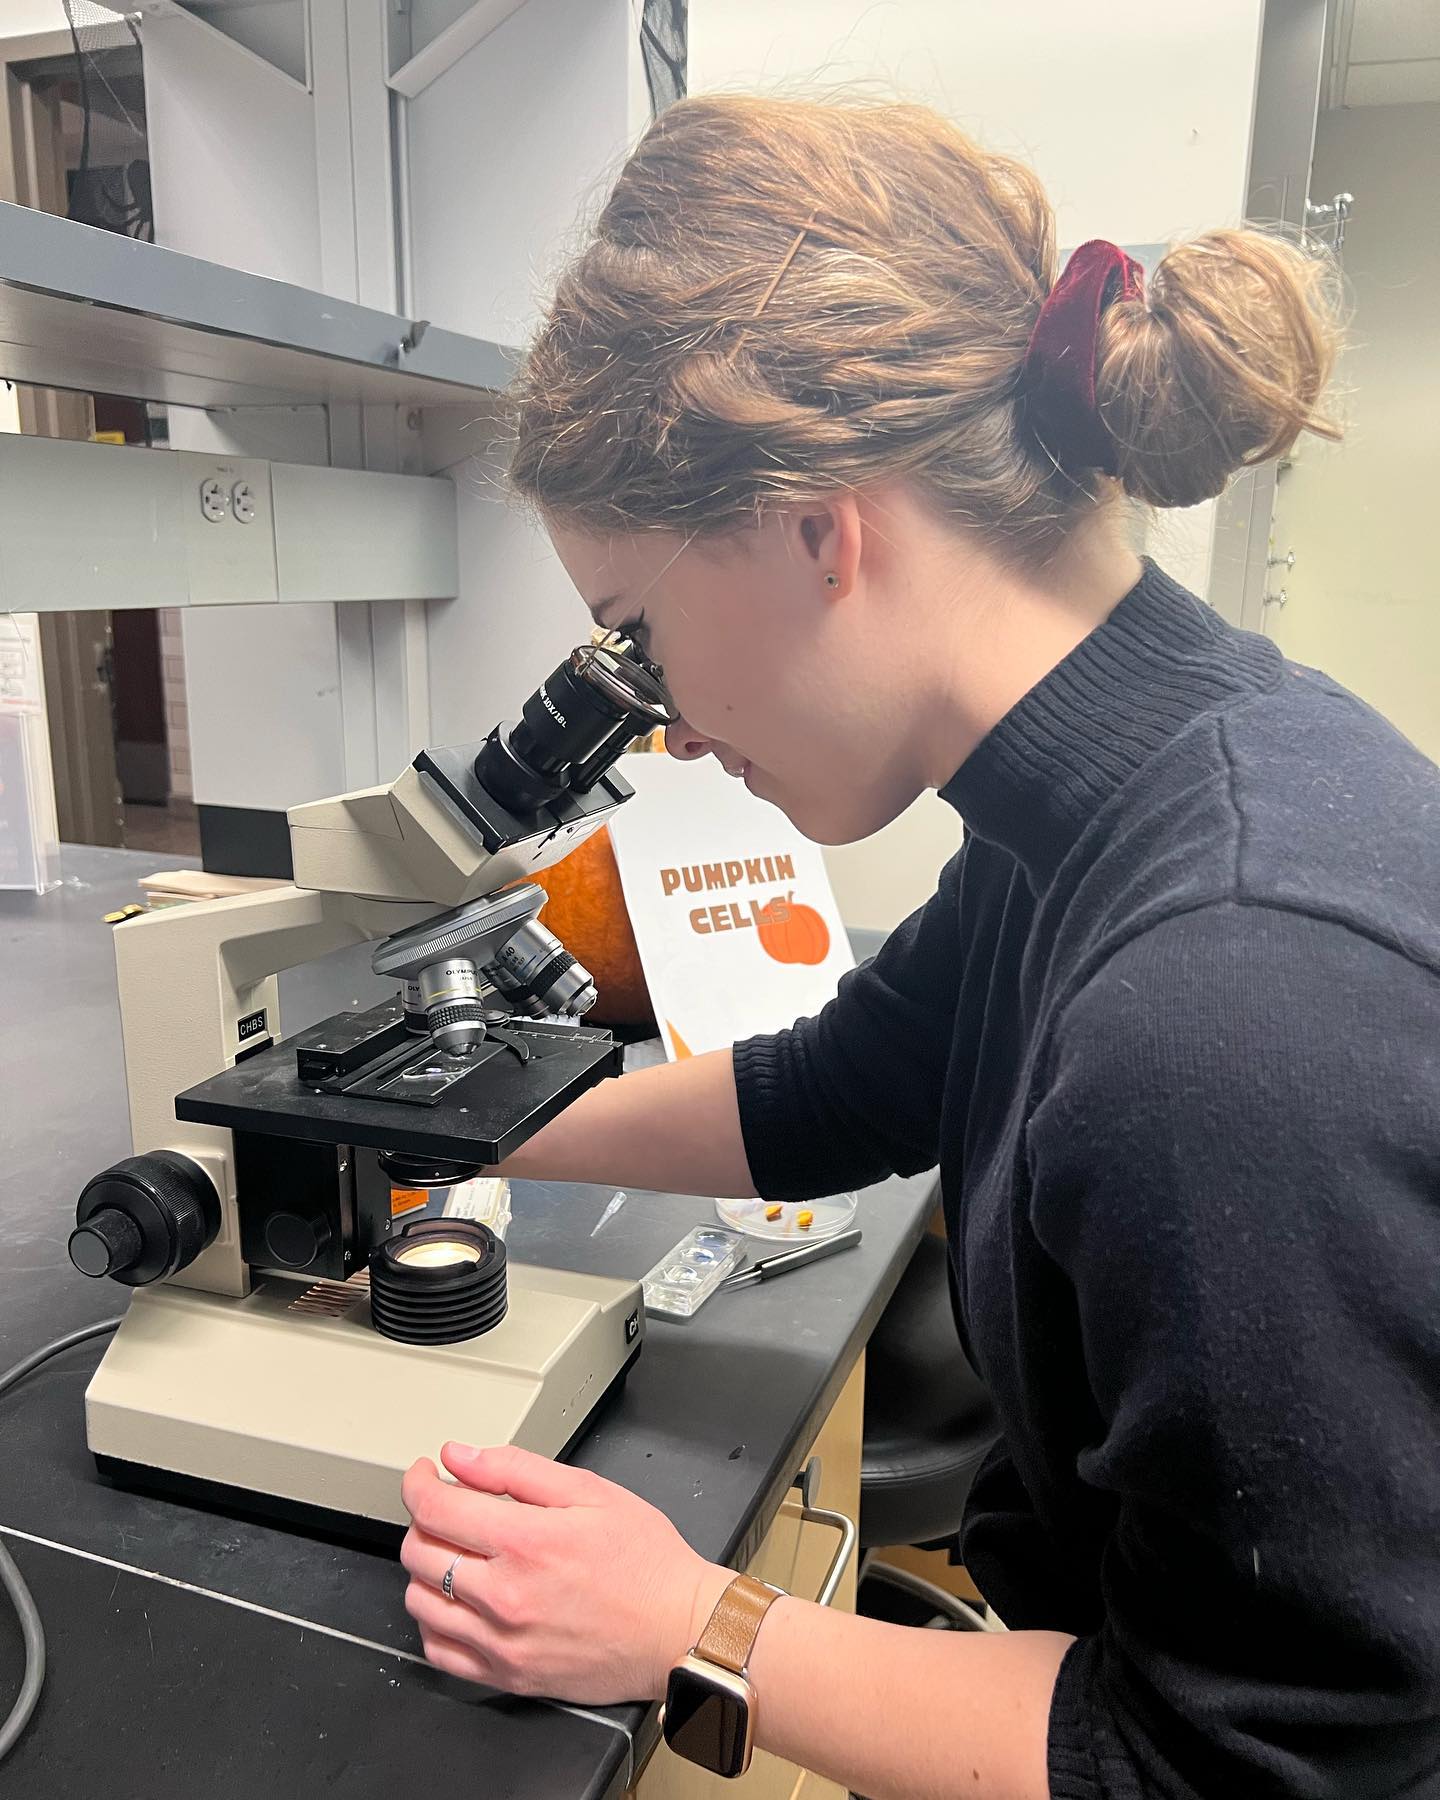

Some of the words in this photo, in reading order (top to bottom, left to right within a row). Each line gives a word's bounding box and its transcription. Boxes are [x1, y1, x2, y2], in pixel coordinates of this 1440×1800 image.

[660, 854, 796, 896] PUMPKIN
[689, 896, 790, 934] CELLS
[240, 1016, 263, 1035] CHBS
